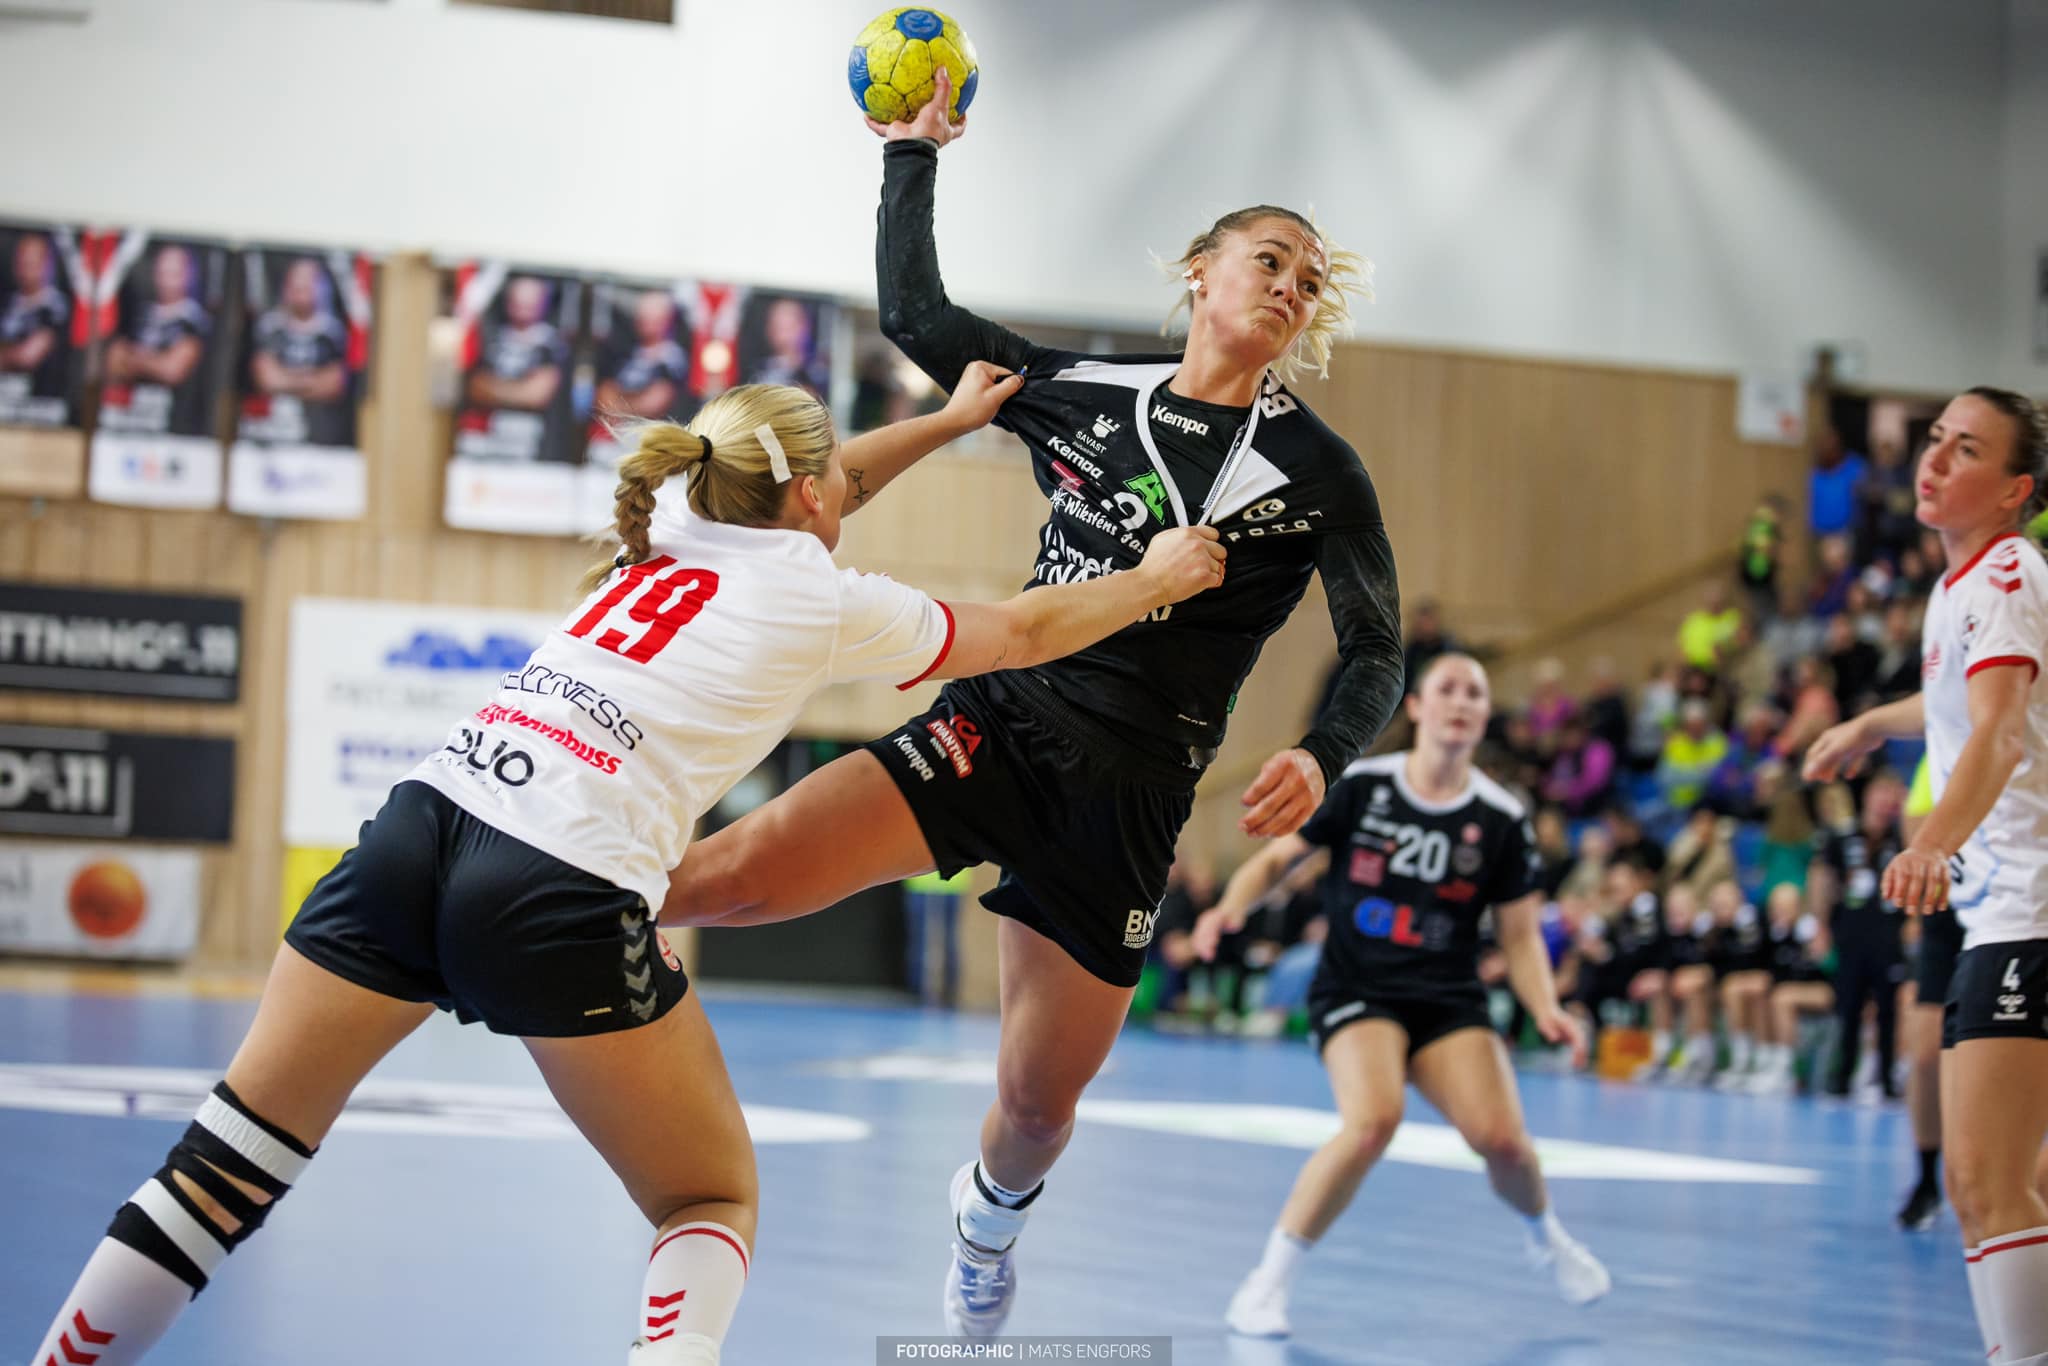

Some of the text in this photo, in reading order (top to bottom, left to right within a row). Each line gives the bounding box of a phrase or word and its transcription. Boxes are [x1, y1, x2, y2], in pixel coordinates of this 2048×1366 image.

[1151, 404, 1209, 437] Kempa
[1047, 436, 1104, 479] Kempa
[563, 554, 720, 665] 19
[893, 733, 935, 782] Kempa
[930, 719, 970, 775] KVANTUM
[1390, 824, 1451, 884] 20
[2001, 957, 2021, 993] 4
